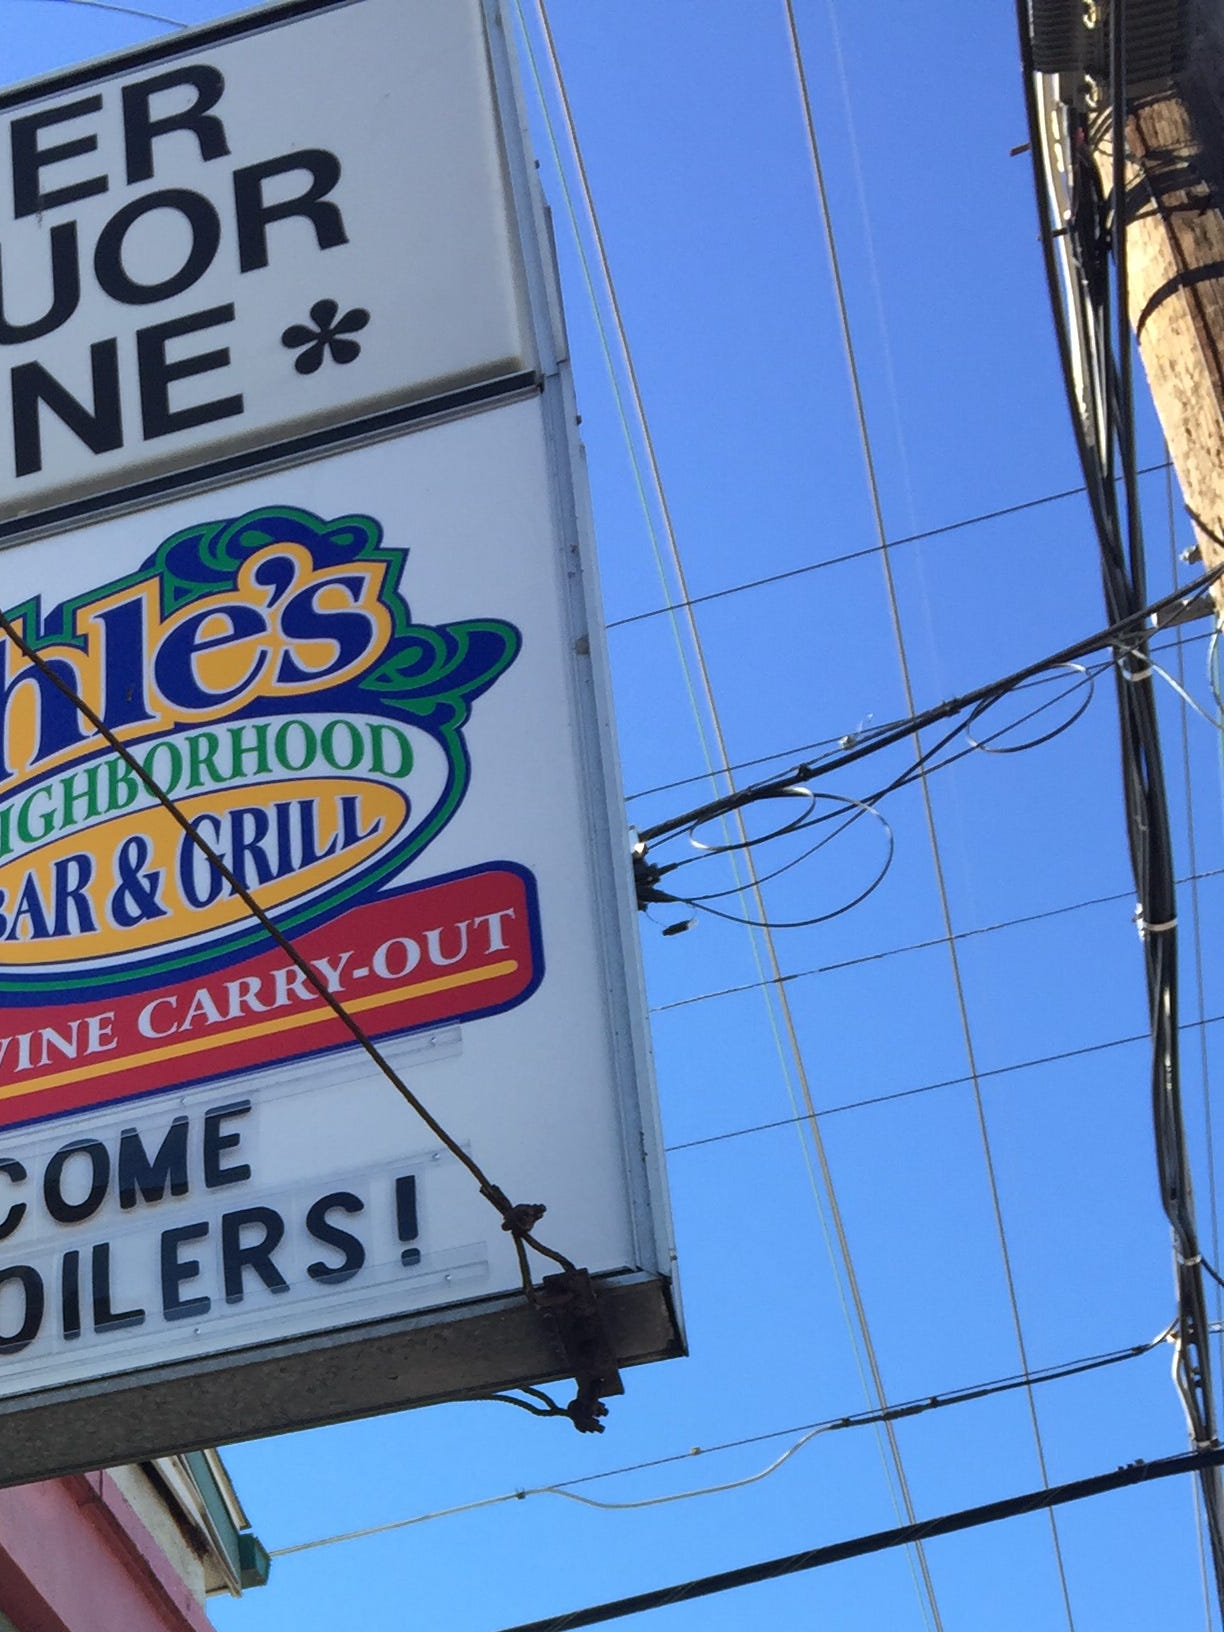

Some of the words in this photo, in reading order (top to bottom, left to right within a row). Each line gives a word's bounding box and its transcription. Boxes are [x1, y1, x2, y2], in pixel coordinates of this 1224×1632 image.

[111, 835, 166, 929] &
[179, 795, 386, 909] GRILL
[136, 906, 516, 1043] CARRY-OUT
